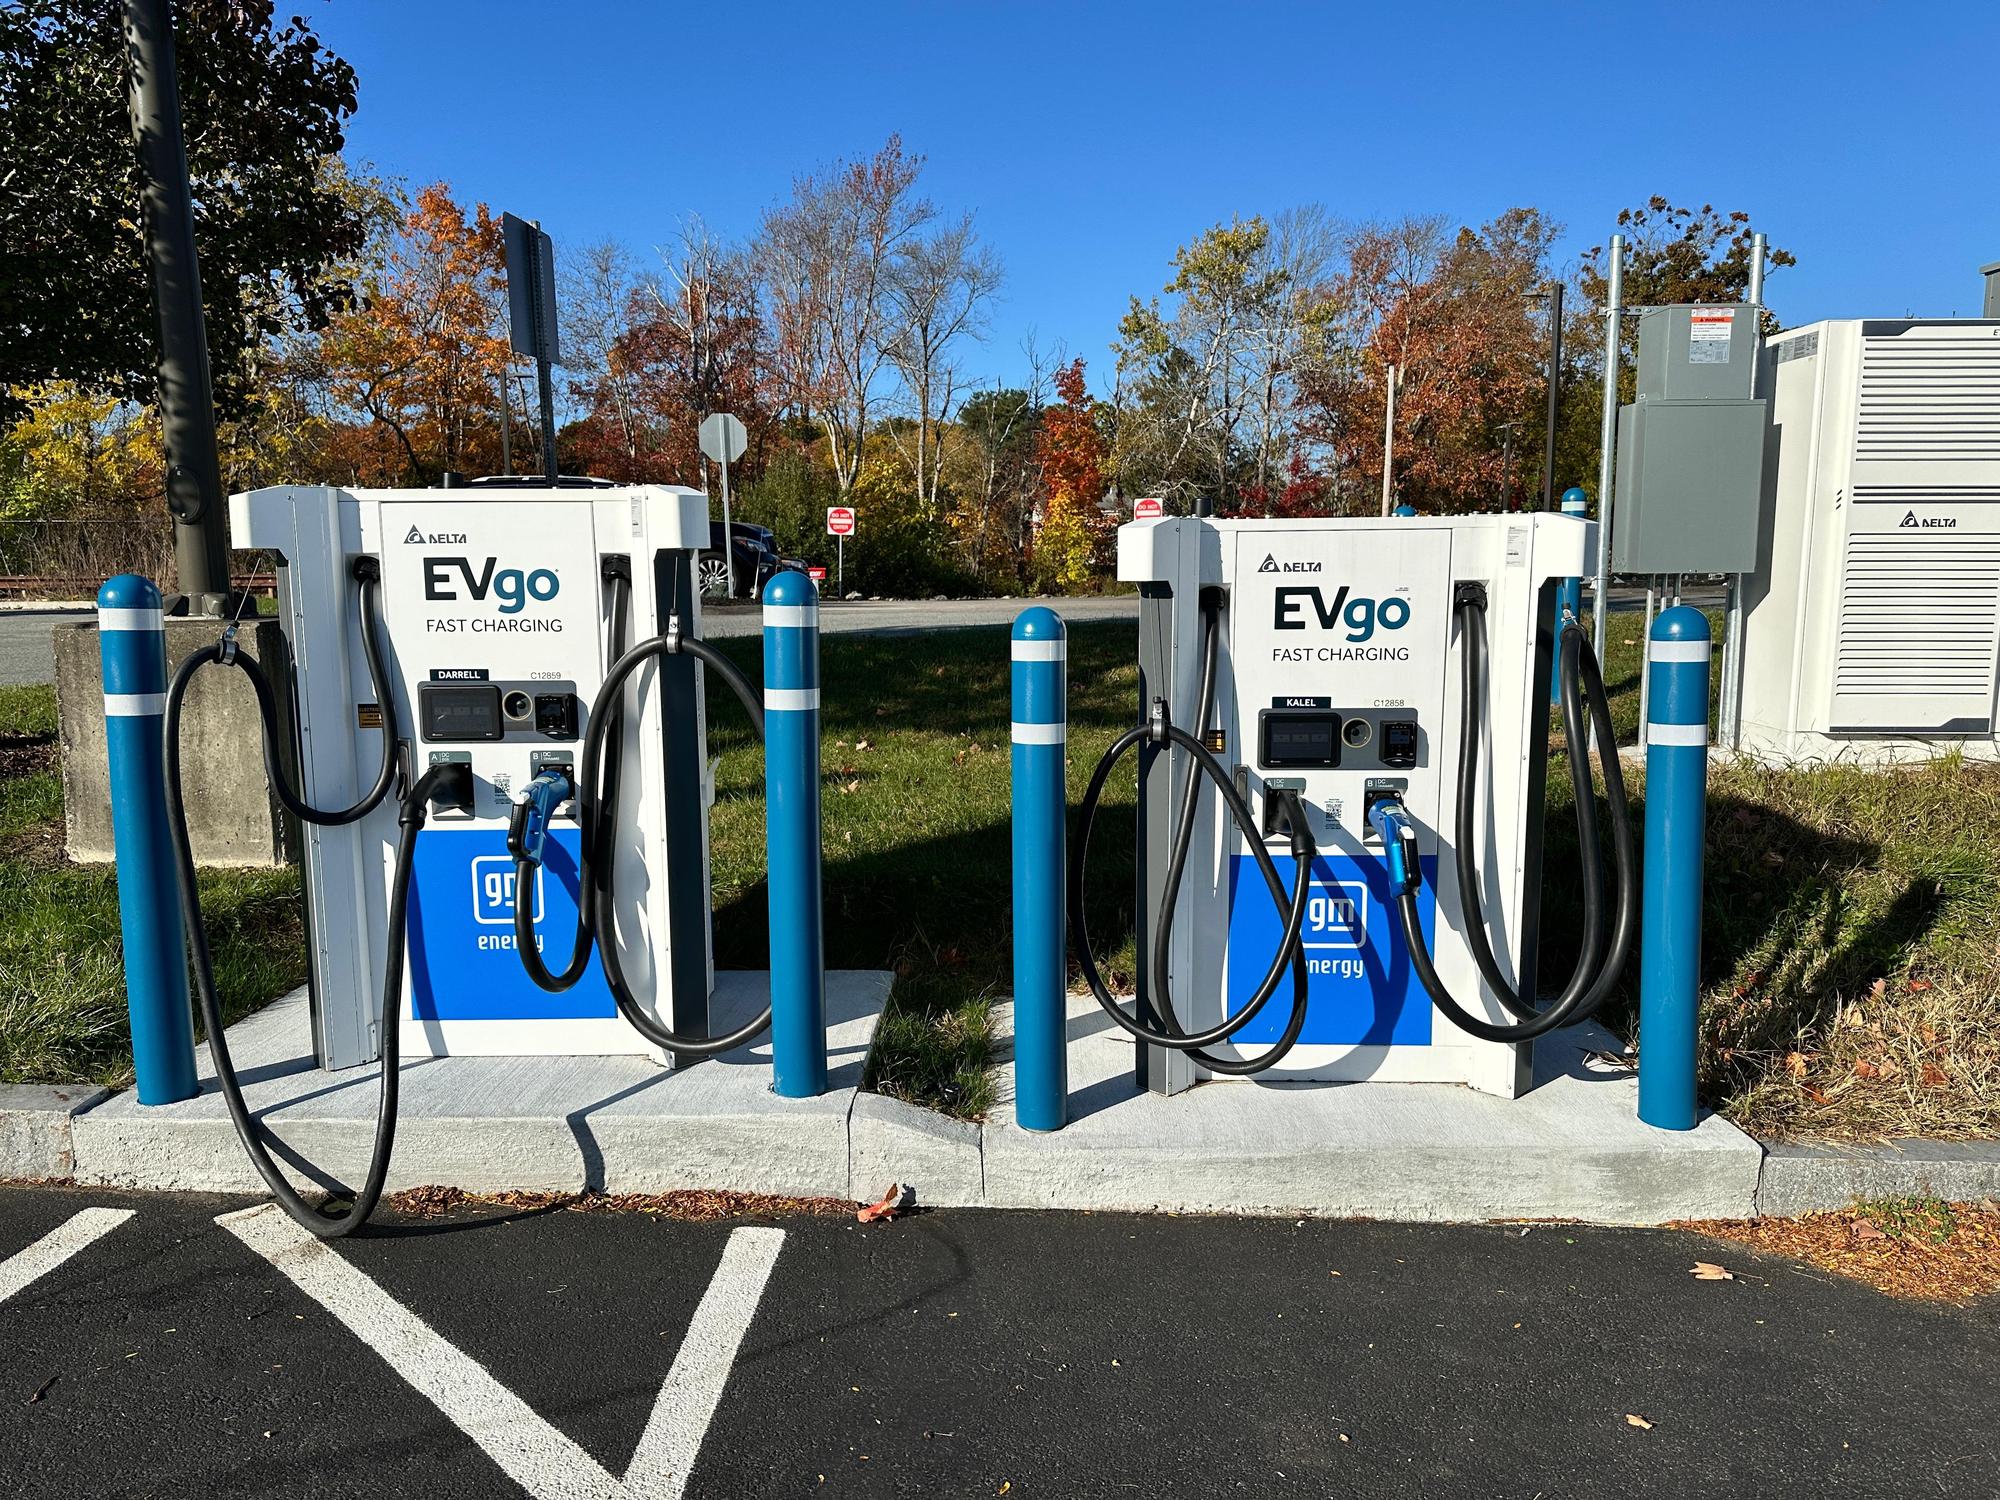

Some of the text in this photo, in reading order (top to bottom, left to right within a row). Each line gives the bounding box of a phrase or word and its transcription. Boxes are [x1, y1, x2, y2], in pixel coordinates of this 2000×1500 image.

[1921, 518, 1957, 528] DELTA
[428, 533, 467, 544] DELTA
[1283, 561, 1322, 573] DELTA
[423, 557, 560, 614] EVgo
[1274, 586, 1411, 643] EVgo
[426, 618, 563, 633] FAST CHARGING
[1272, 647, 1410, 662] FAST CHARGING
[438, 670, 481, 679] DARRELL
[530, 671, 562, 680] C12859
[1286, 698, 1317, 707] KALEL
[1373, 699, 1405, 708] C12858
[431, 753, 438, 761] A
[532, 752, 539, 760] B
[1266, 779, 1273, 788] A
[1367, 779, 1374, 787] B
[1309, 898, 1355, 932] gm
[477, 934, 544, 954] enery
[1305, 959, 1364, 979] nergy
